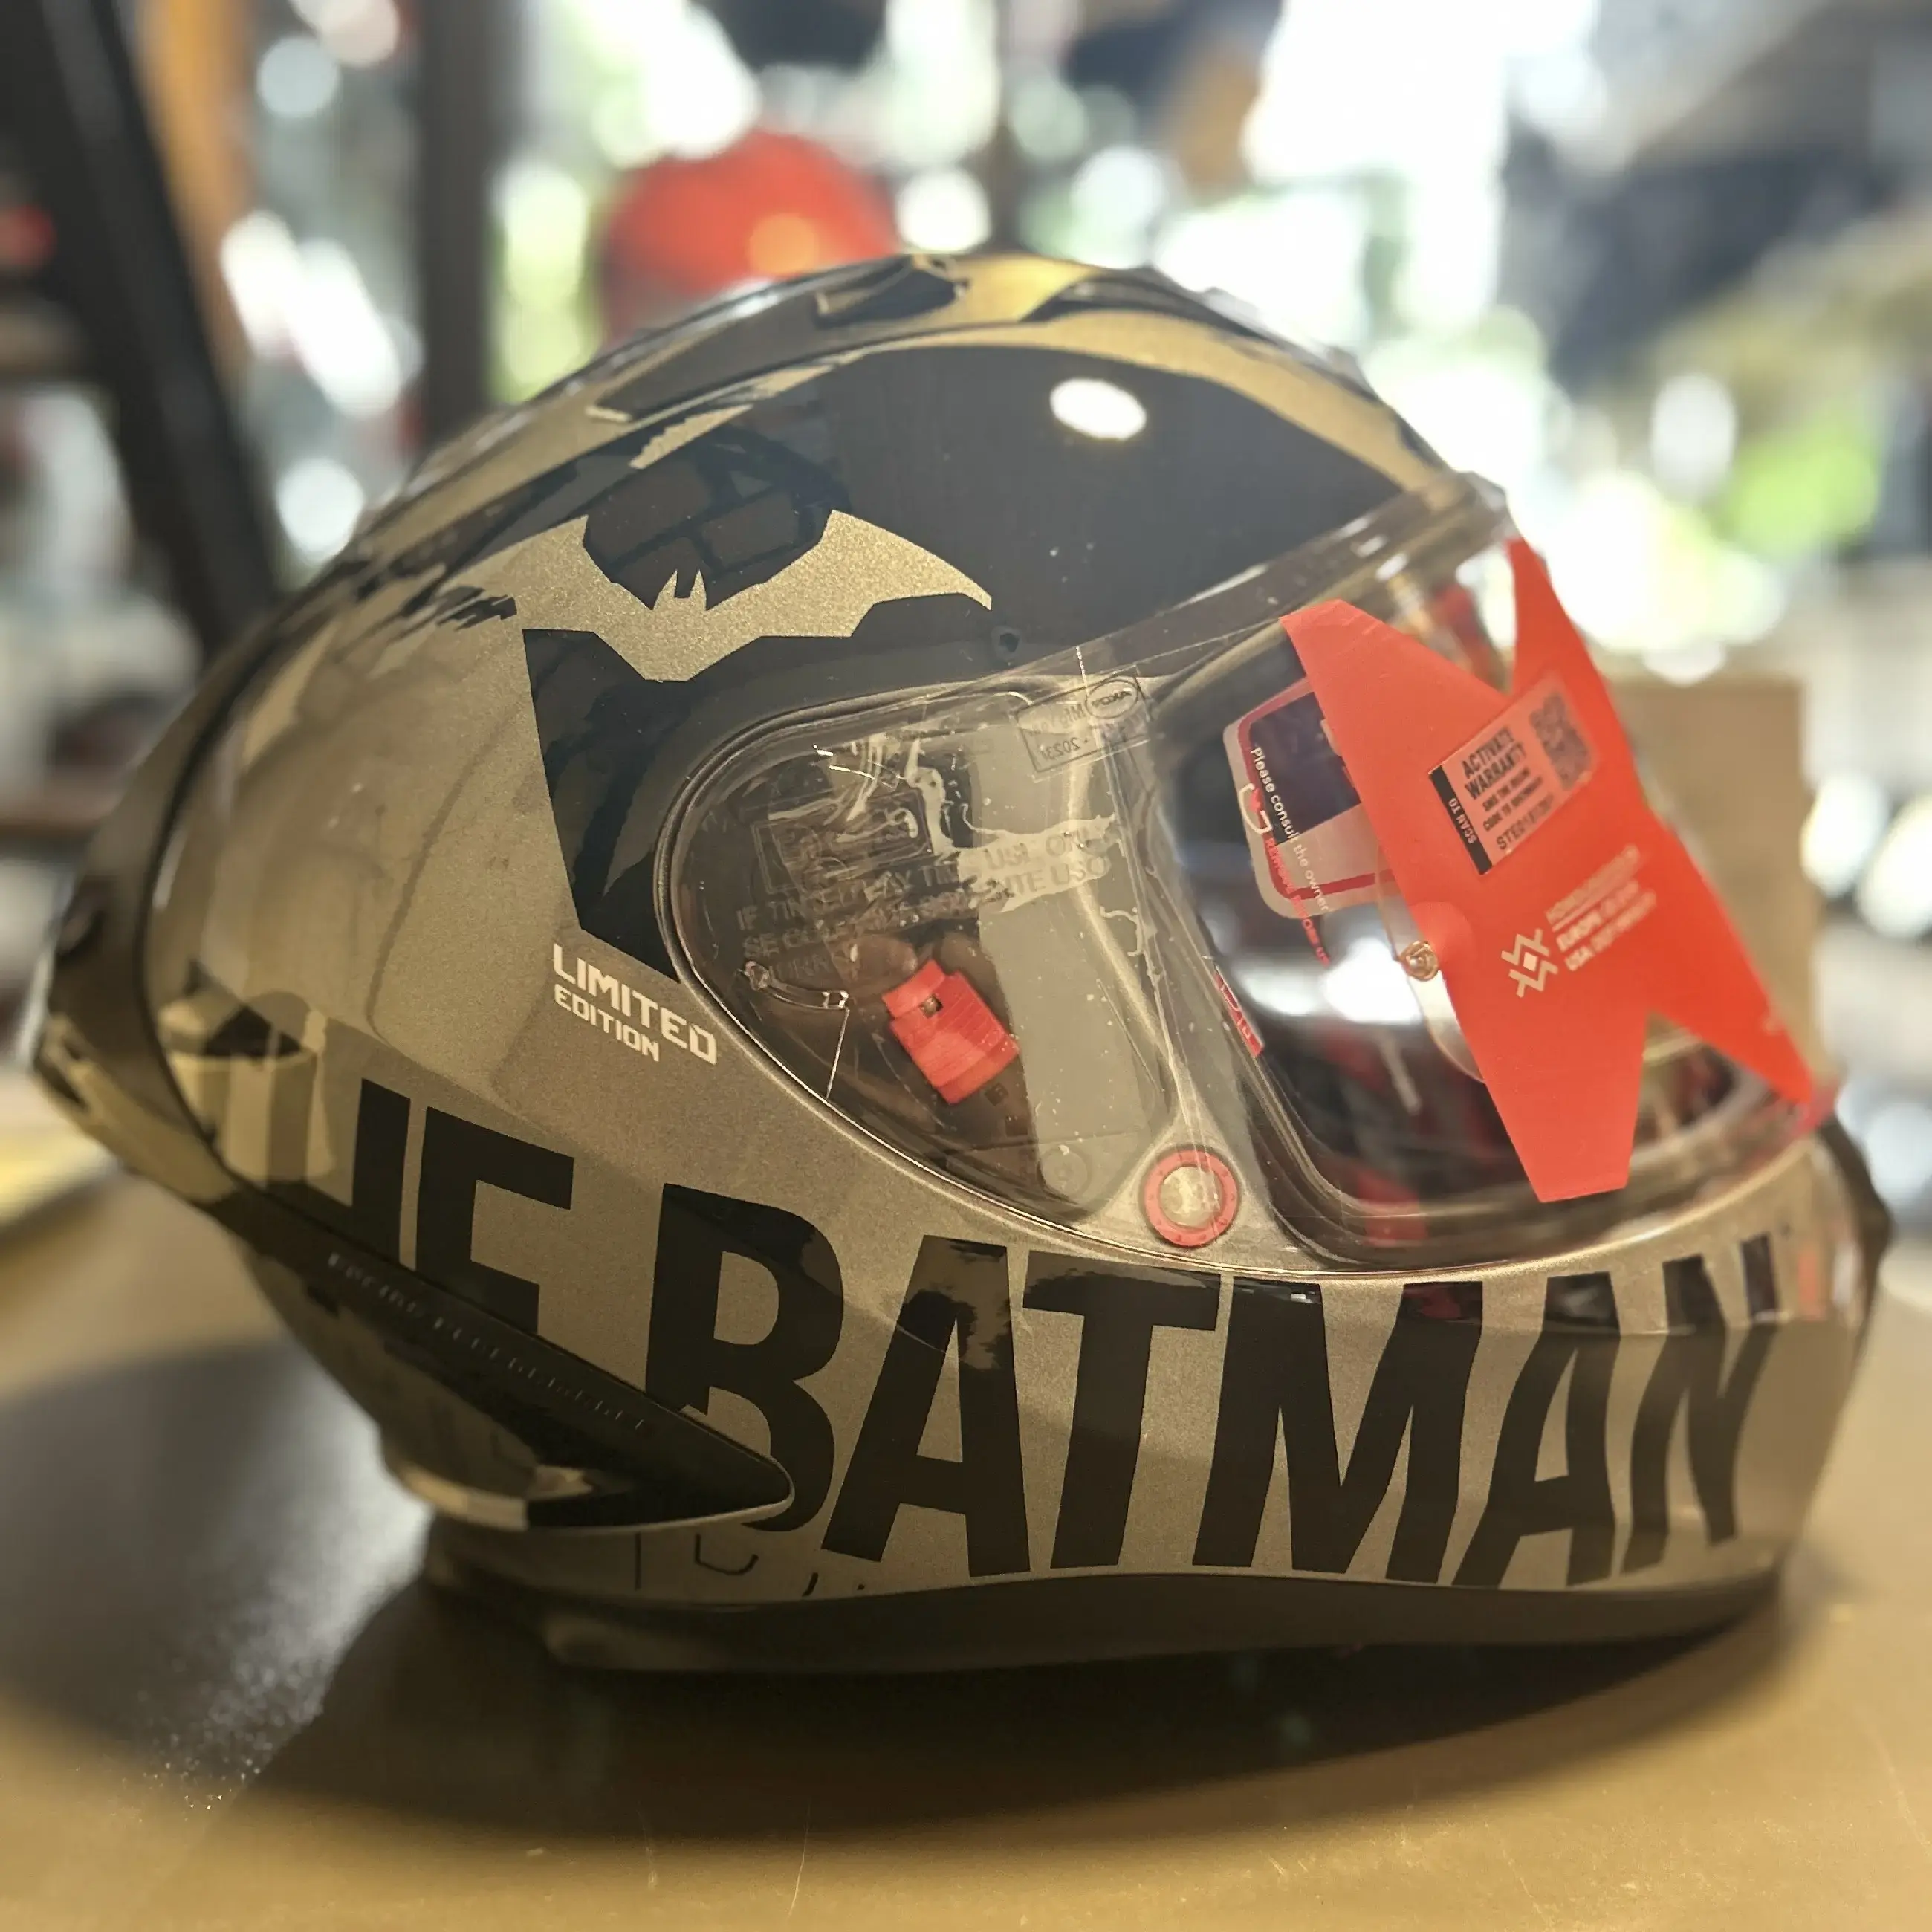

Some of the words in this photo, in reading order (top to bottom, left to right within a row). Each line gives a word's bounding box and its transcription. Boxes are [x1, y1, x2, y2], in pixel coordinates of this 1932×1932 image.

[1250, 745, 1276, 793] Please
[1271, 794, 1300, 843] consult
[1293, 843, 1309, 868] the
[553, 943, 717, 1065] LIMITED
[555, 983, 659, 1062] EDITION
[645, 1183, 1781, 1590] BATMAN
